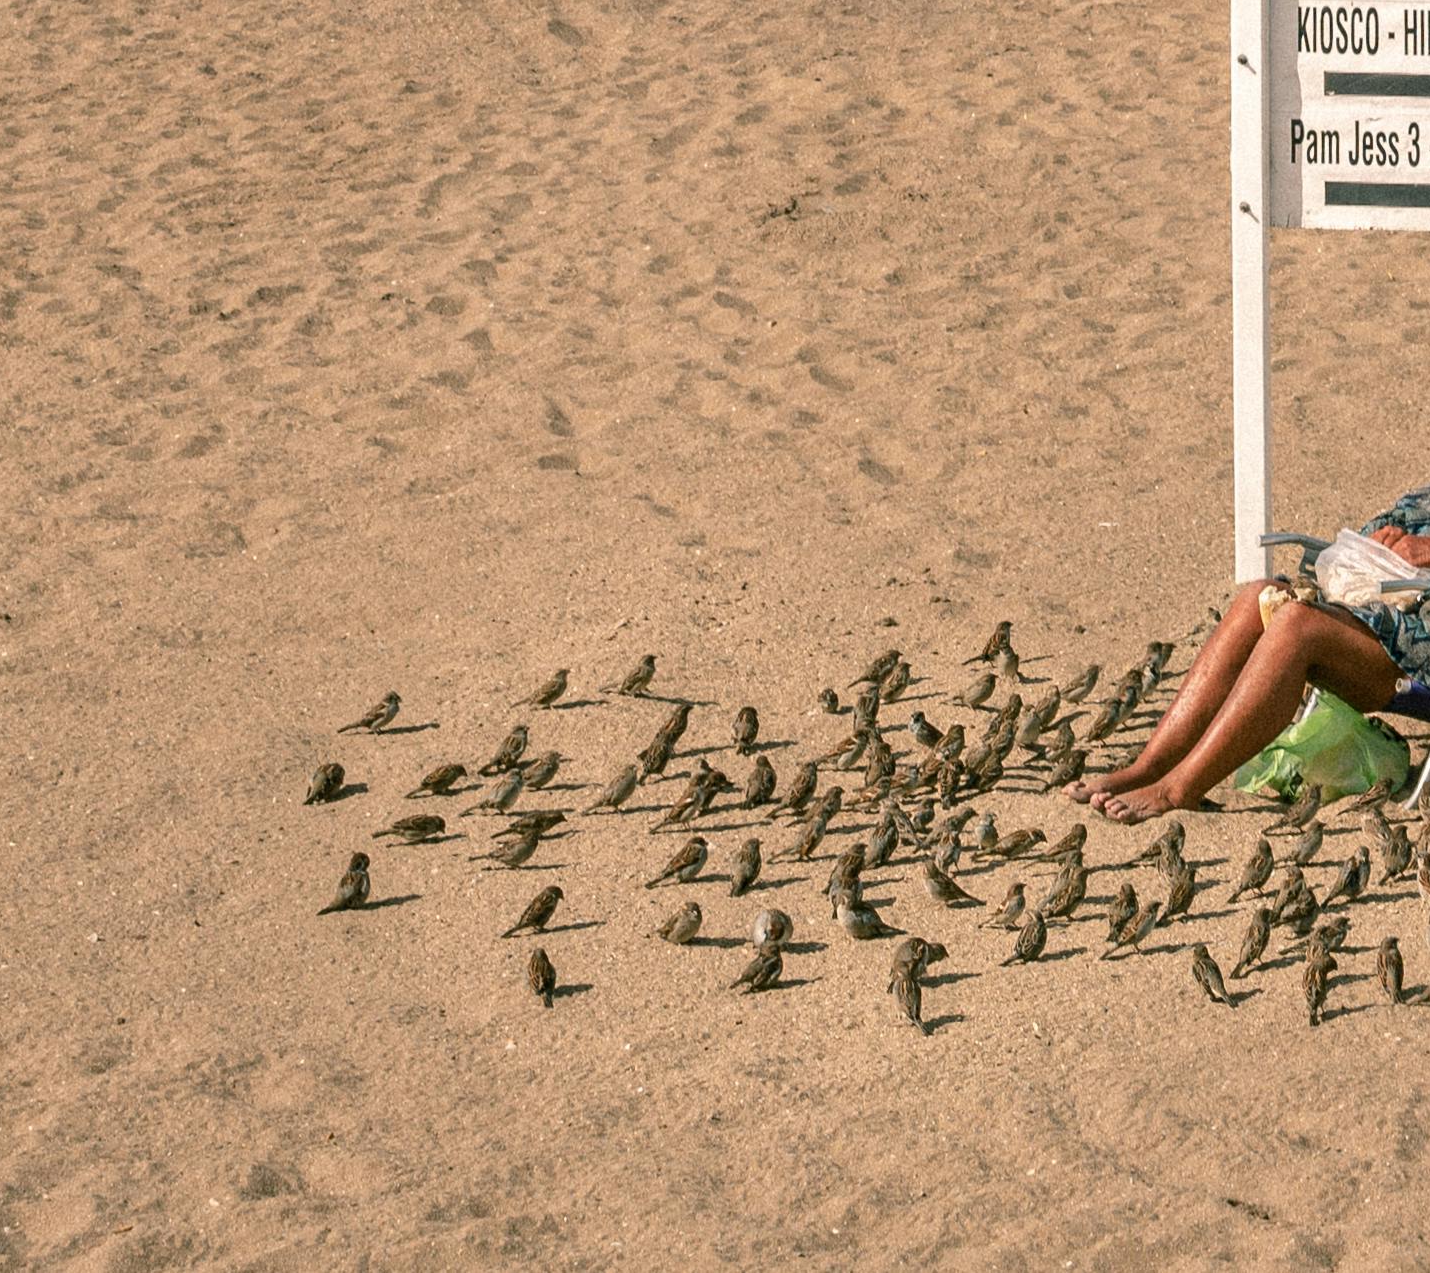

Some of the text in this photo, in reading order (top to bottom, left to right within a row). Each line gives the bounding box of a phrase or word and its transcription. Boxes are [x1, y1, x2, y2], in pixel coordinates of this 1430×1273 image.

[1297, 5, 1380, 55] KIOSCO
[1290, 118, 1340, 165] Pam
[1348, 120, 1400, 167] Jess
[1407, 121, 1421, 167] 3
